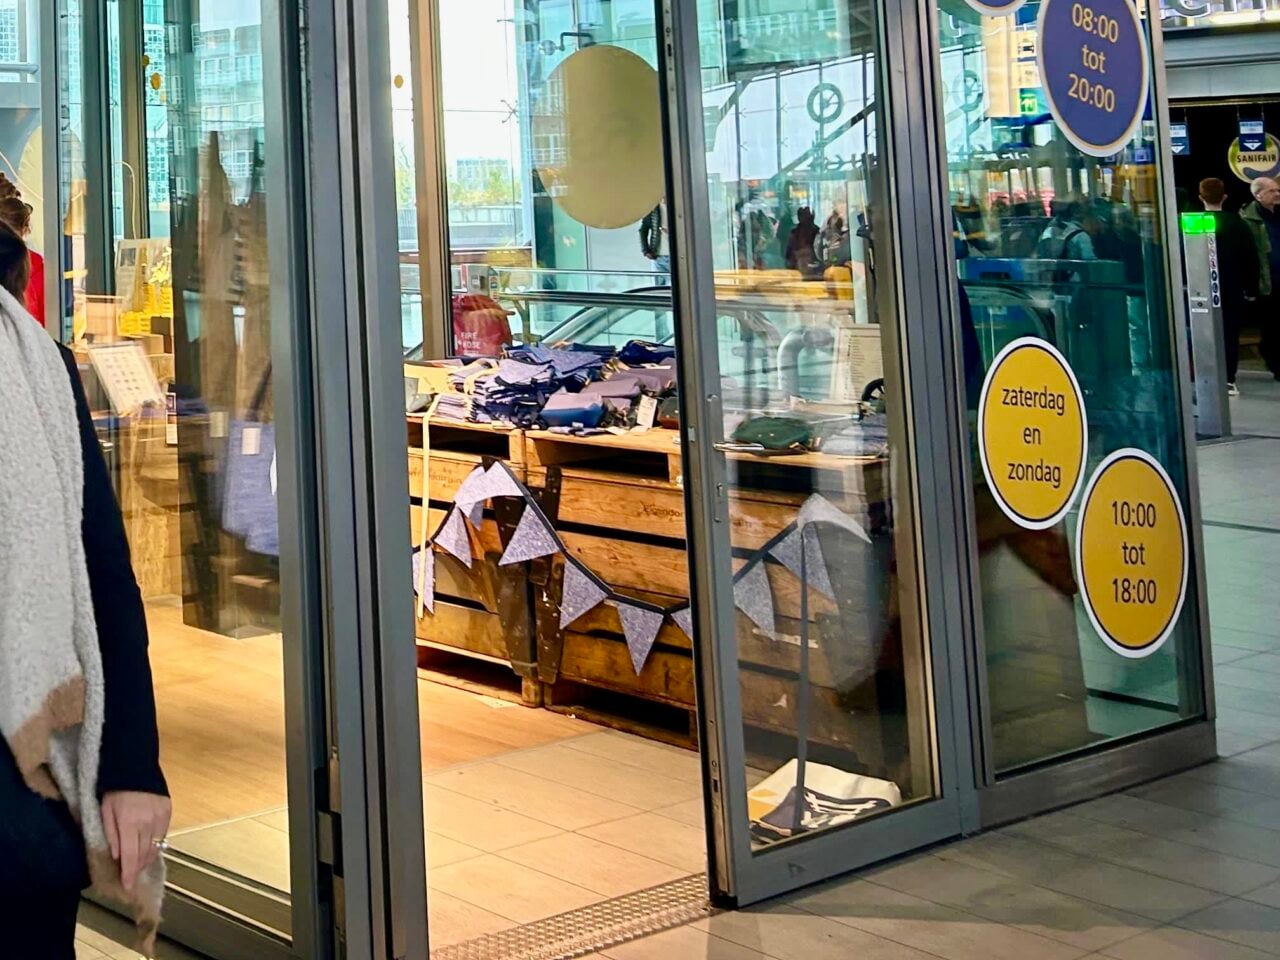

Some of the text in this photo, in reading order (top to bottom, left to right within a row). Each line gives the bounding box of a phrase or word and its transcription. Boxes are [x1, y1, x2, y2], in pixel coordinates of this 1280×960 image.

[1072, 3, 1119, 43] 08:00
[1081, 44, 1106, 74] tot
[1068, 73, 1115, 113] 20:00
[1236, 154, 1277, 163] SANIFAIR
[1002, 386, 1065, 416] zaterdag
[1023, 426, 1041, 445] en
[1008, 460, 1061, 489] zondag
[1112, 501, 1156, 529] 10:00
[1122, 542, 1146, 565] tot
[1112, 578, 1157, 605] 18:00
